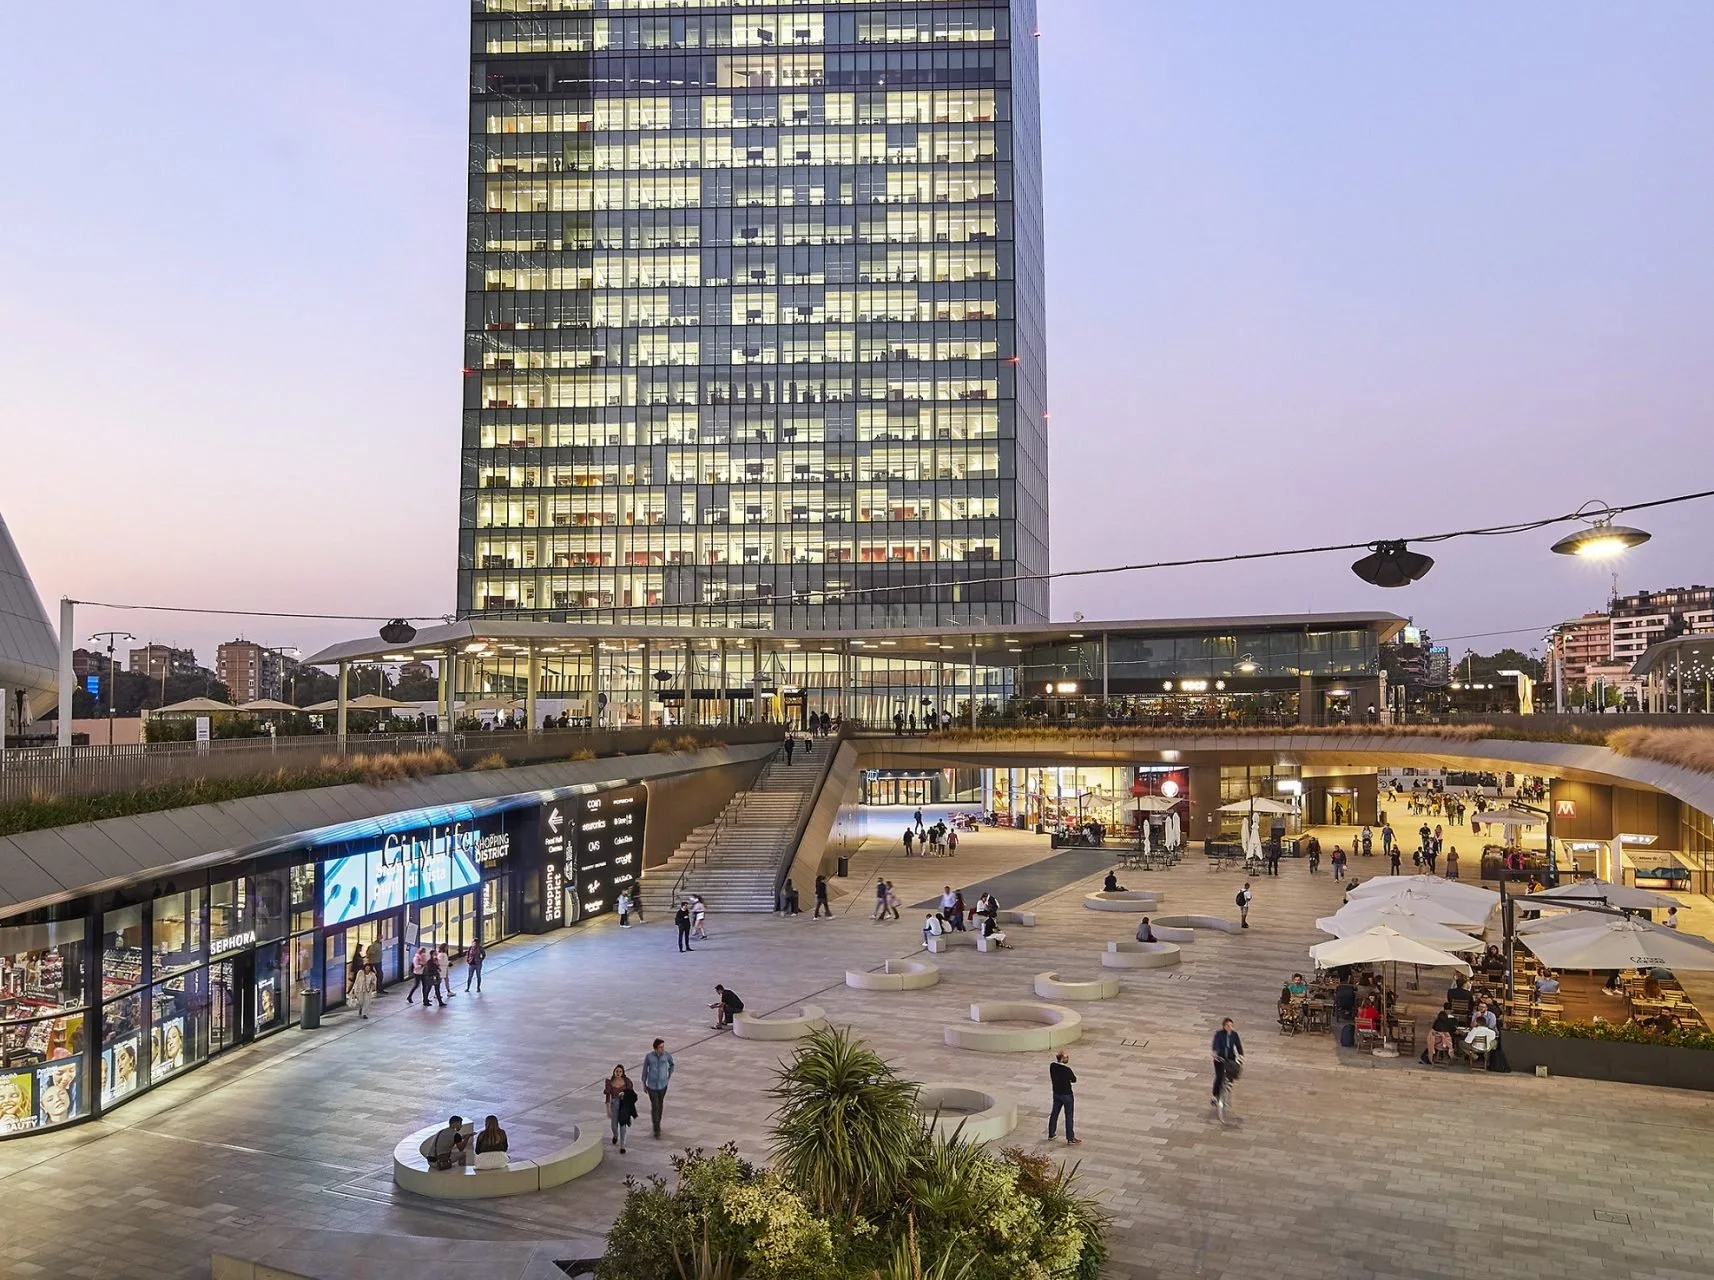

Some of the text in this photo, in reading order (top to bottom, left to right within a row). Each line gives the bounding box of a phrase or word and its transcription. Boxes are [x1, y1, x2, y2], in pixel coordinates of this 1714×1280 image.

[383, 822, 471, 871] CityLife
[475, 833, 509, 850] SHOPPING
[475, 845, 509, 863] DISTRICT
[546, 864, 555, 922] Shopping
[554, 873, 562, 919] District
[210, 930, 256, 955] SEPHORA
